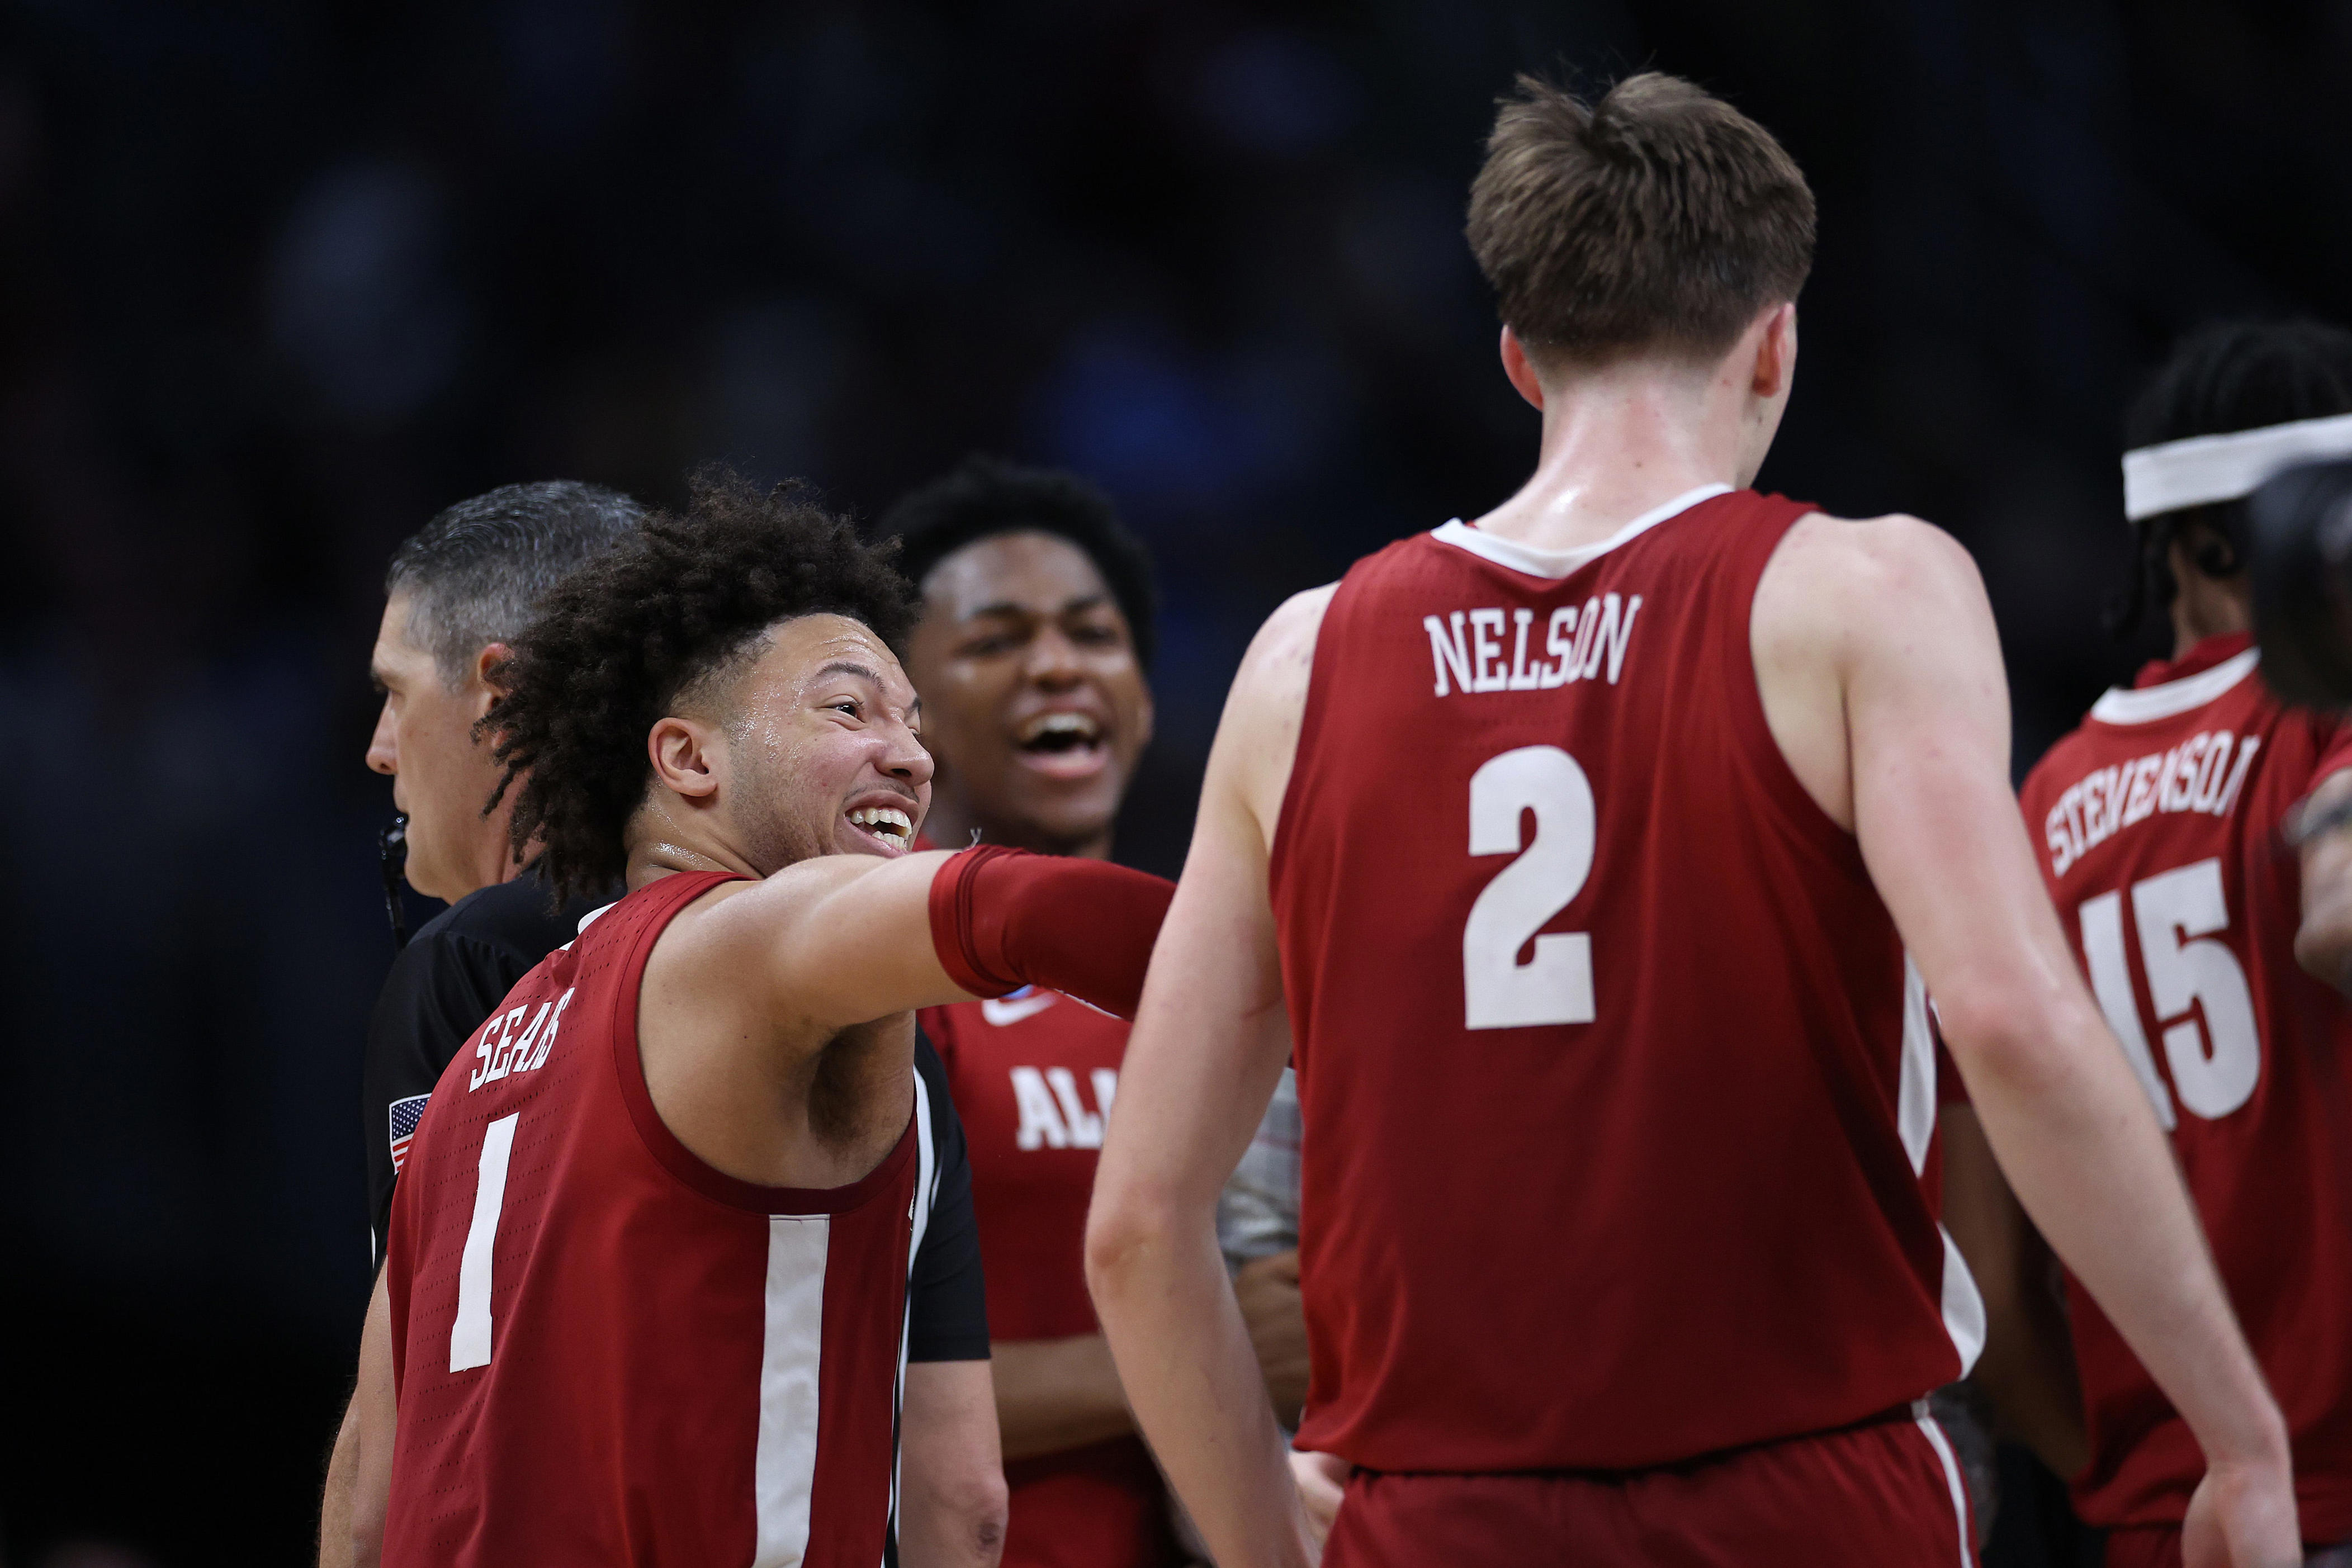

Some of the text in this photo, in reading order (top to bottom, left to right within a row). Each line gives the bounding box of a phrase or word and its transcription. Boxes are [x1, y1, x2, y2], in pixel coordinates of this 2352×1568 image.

[1423, 592, 1643, 697] NELSON
[1463, 744, 1597, 1030] 2
[2077, 856, 2261, 1133] 15
[449, 1111, 520, 1373] 1
